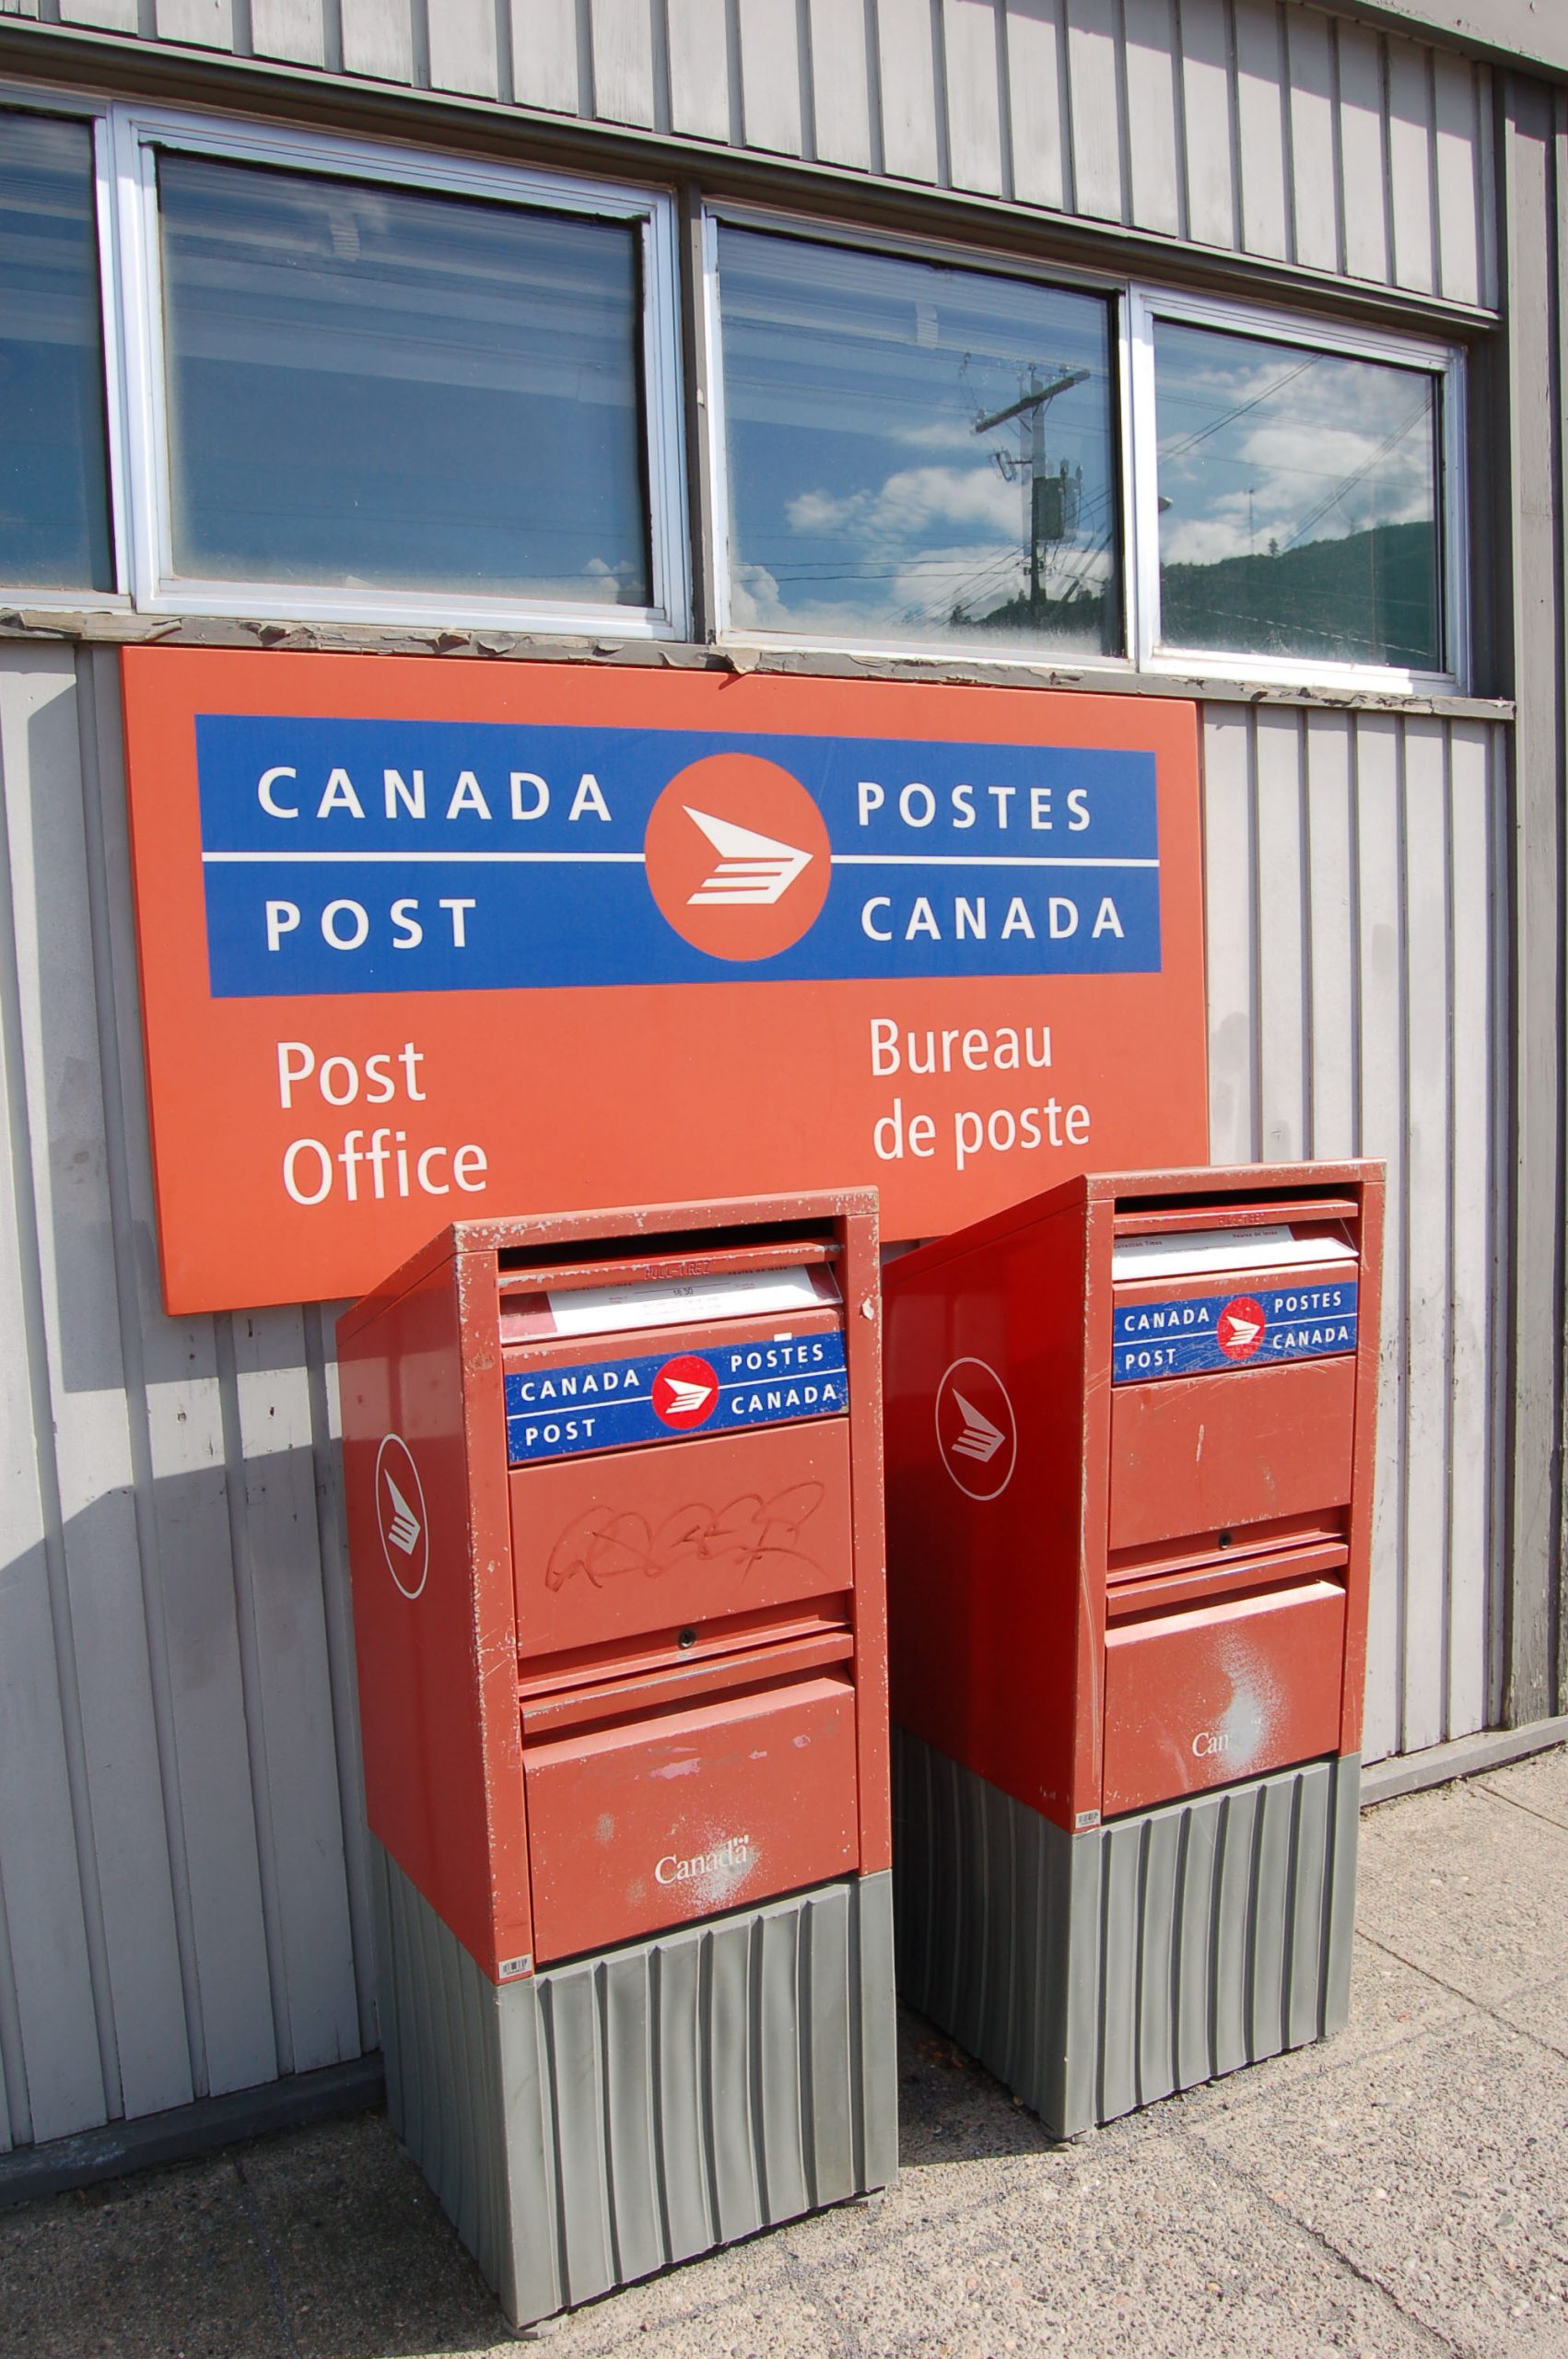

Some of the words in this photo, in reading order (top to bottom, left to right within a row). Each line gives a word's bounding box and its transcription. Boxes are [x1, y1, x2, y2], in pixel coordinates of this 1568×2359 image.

[257, 765, 613, 821] CANADA
[857, 781, 1091, 832] POSTES
[264, 898, 477, 952] POST
[860, 896, 1125, 942] CANADA
[869, 1017, 1052, 1076] Bureau
[276, 1041, 427, 1109] Post
[872, 1097, 936, 1160] de
[954, 1097, 1091, 1171] poste
[283, 1128, 488, 1205] Office
[1124, 1306, 1211, 1332] CANADA
[1274, 1290, 1342, 1313] POSTES
[731, 1343, 825, 1372] POSTES
[1124, 1348, 1175, 1370] POST
[1272, 1325, 1350, 1350] CANADA
[520, 1368, 641, 1402] CANADA
[731, 1382, 837, 1415] CANADA
[524, 1418, 597, 1447] POST
[654, 1835, 749, 1884] Canada
